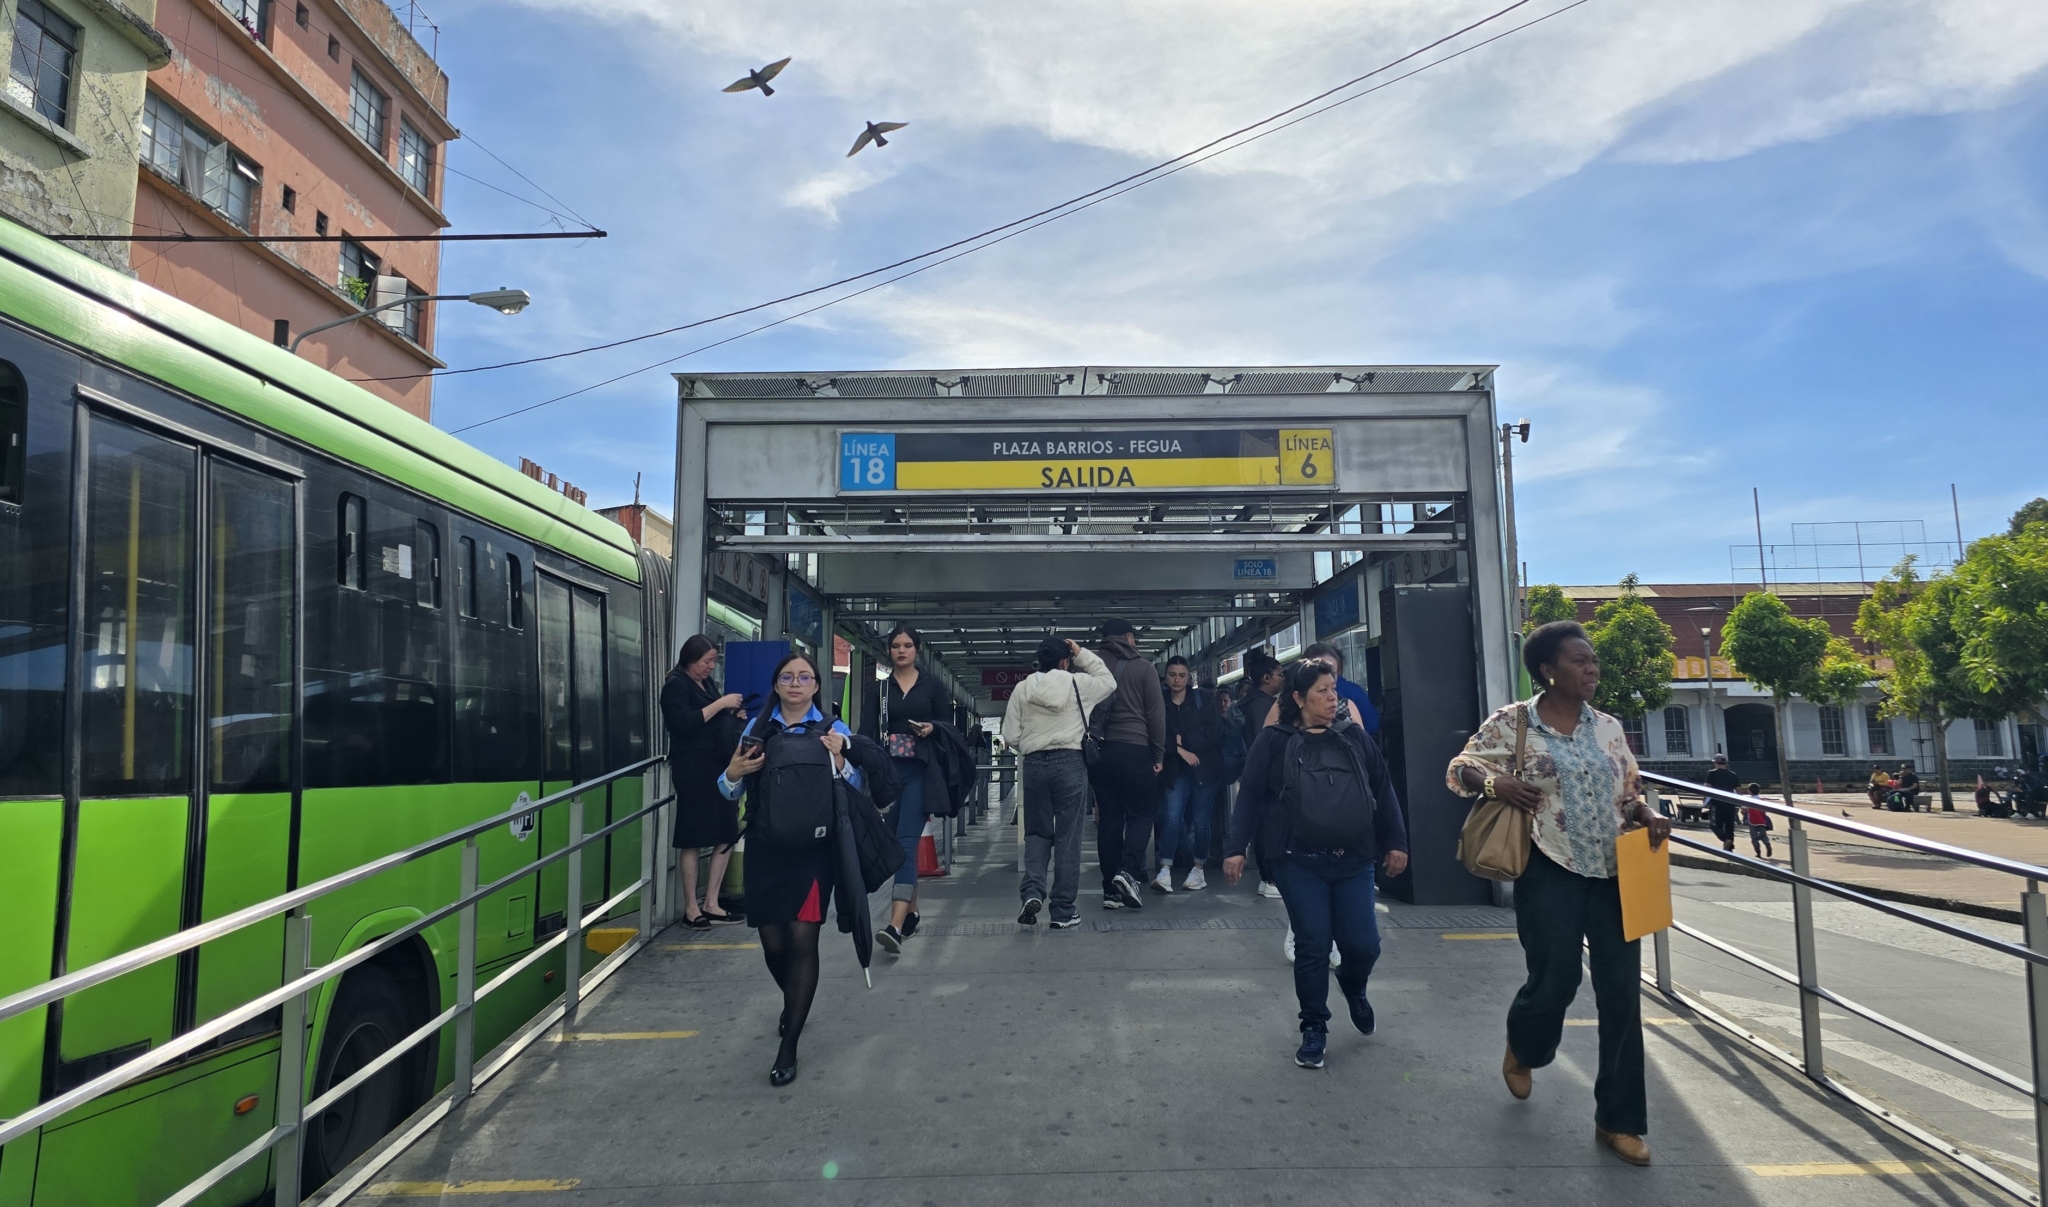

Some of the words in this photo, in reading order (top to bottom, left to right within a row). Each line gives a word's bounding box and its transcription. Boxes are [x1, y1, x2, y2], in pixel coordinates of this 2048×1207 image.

[844, 439, 890, 457] LÍNEA
[993, 442, 1042, 455] PLAZA
[1046, 440, 1113, 455] BARRIOS
[1130, 439, 1182, 453] FEGUA
[1286, 434, 1331, 451] LÍNEA
[850, 457, 885, 485] 18
[1301, 452, 1317, 479] 6
[1040, 466, 1136, 488] SALIDA
[1262, 568, 1272, 576] 18
